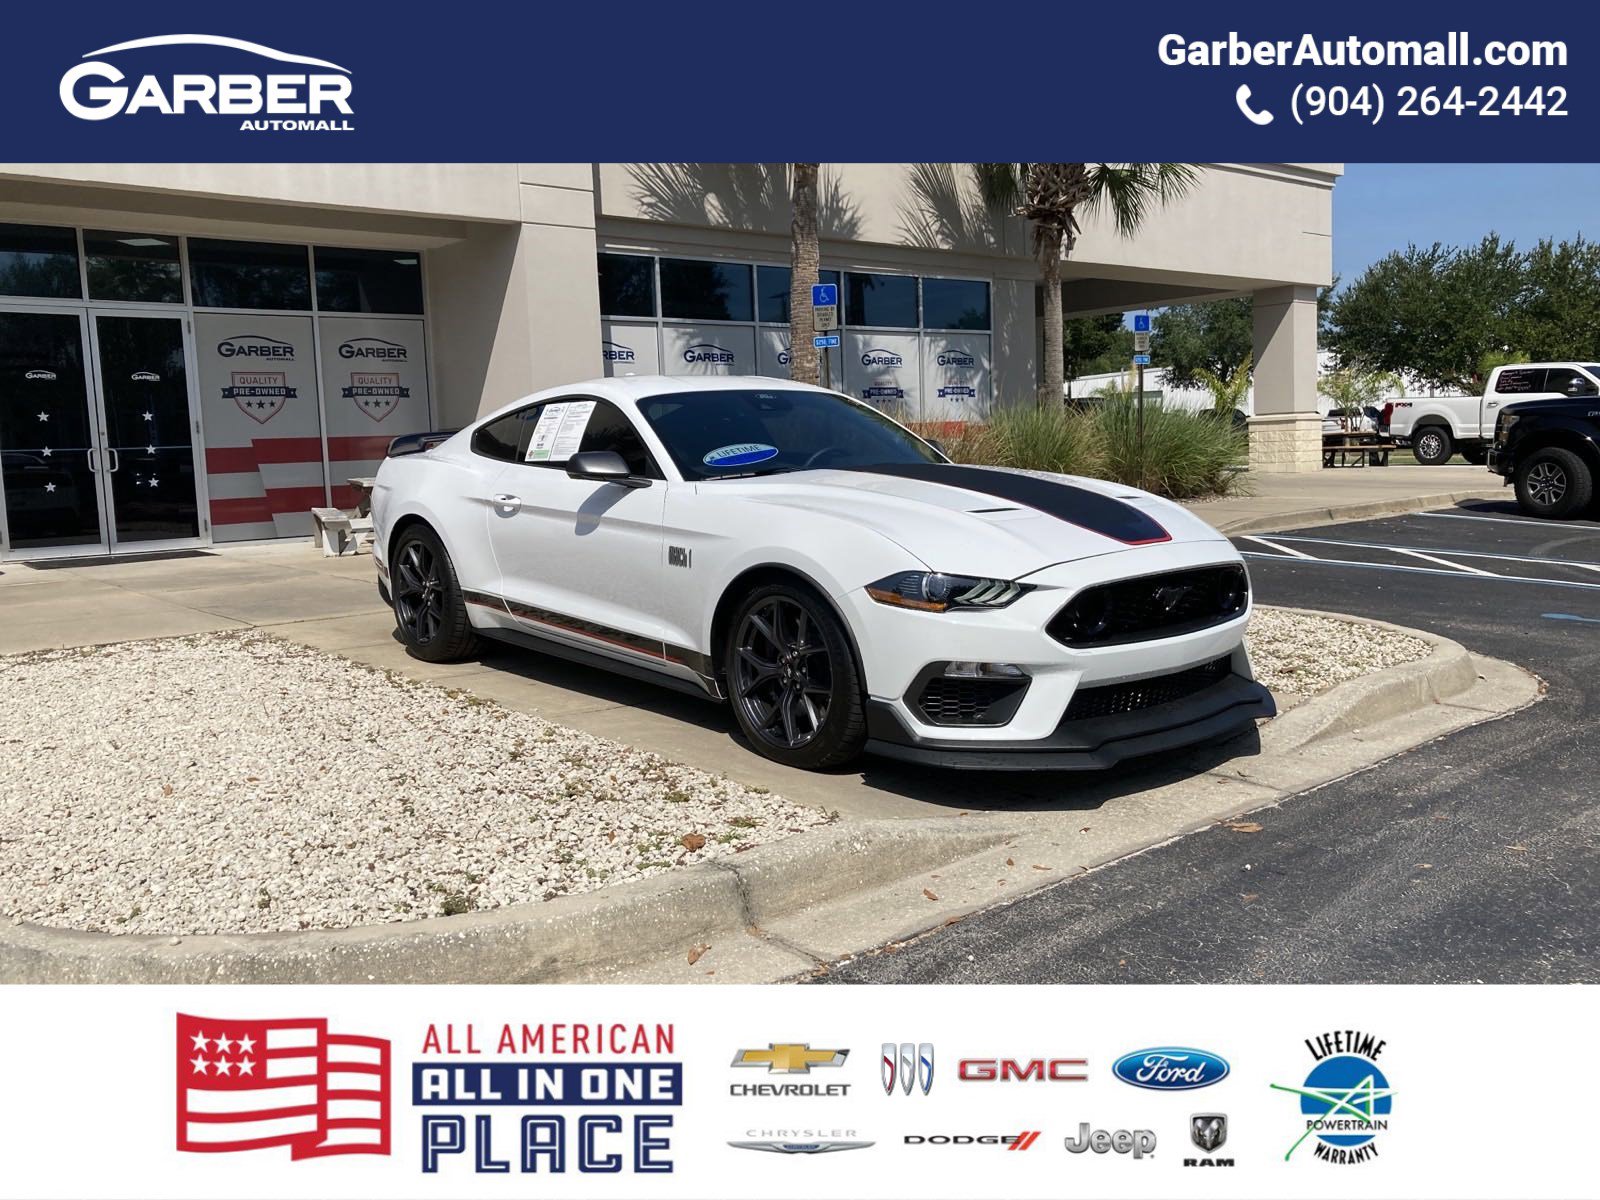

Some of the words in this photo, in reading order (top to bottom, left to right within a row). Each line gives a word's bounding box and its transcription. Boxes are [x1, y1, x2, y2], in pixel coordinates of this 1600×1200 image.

[217, 342, 295, 358] GARBER
[338, 344, 407, 359] GARBER
[602, 351, 635, 360] RBER
[683, 350, 735, 363] GARBER
[861, 354, 903, 366] GARBER
[937, 355, 975, 366] GARBER
[240, 377, 278, 385] QUALITY
[358, 377, 393, 385] QUALITY
[717, 444, 760, 458] LIFETIME
